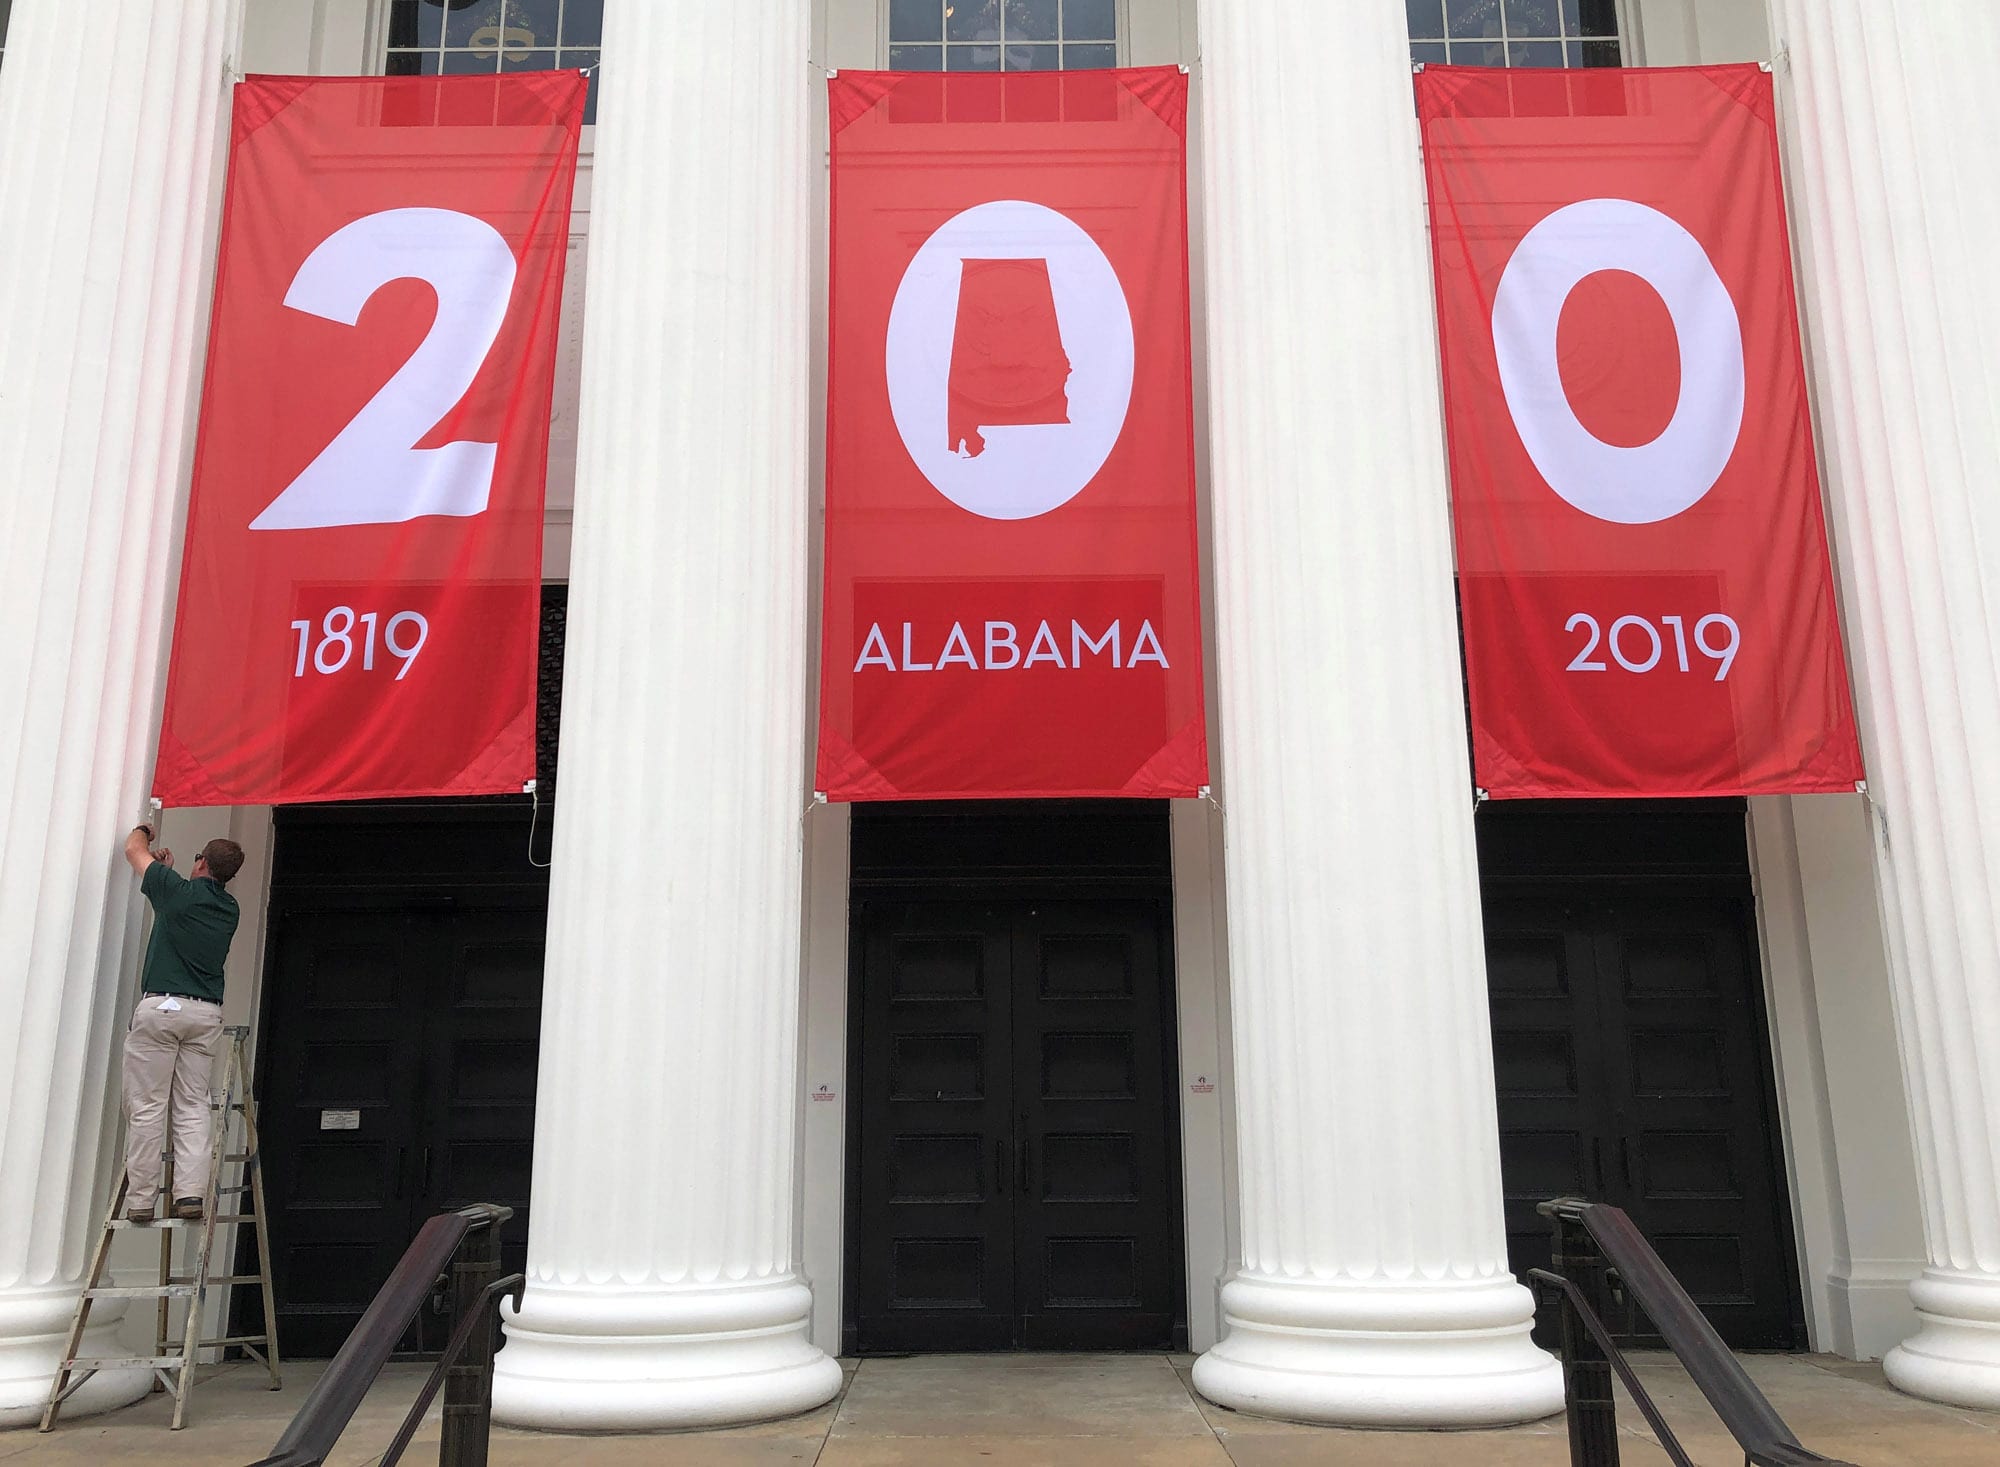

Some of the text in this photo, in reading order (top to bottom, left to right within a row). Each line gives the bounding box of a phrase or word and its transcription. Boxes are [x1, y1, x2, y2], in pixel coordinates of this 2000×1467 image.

[249, 207, 518, 531] 2
[1492, 198, 1746, 525] 0
[291, 606, 429, 681] 1819
[854, 619, 1170, 672] ALABAMA
[1565, 612, 1741, 681] 2019
